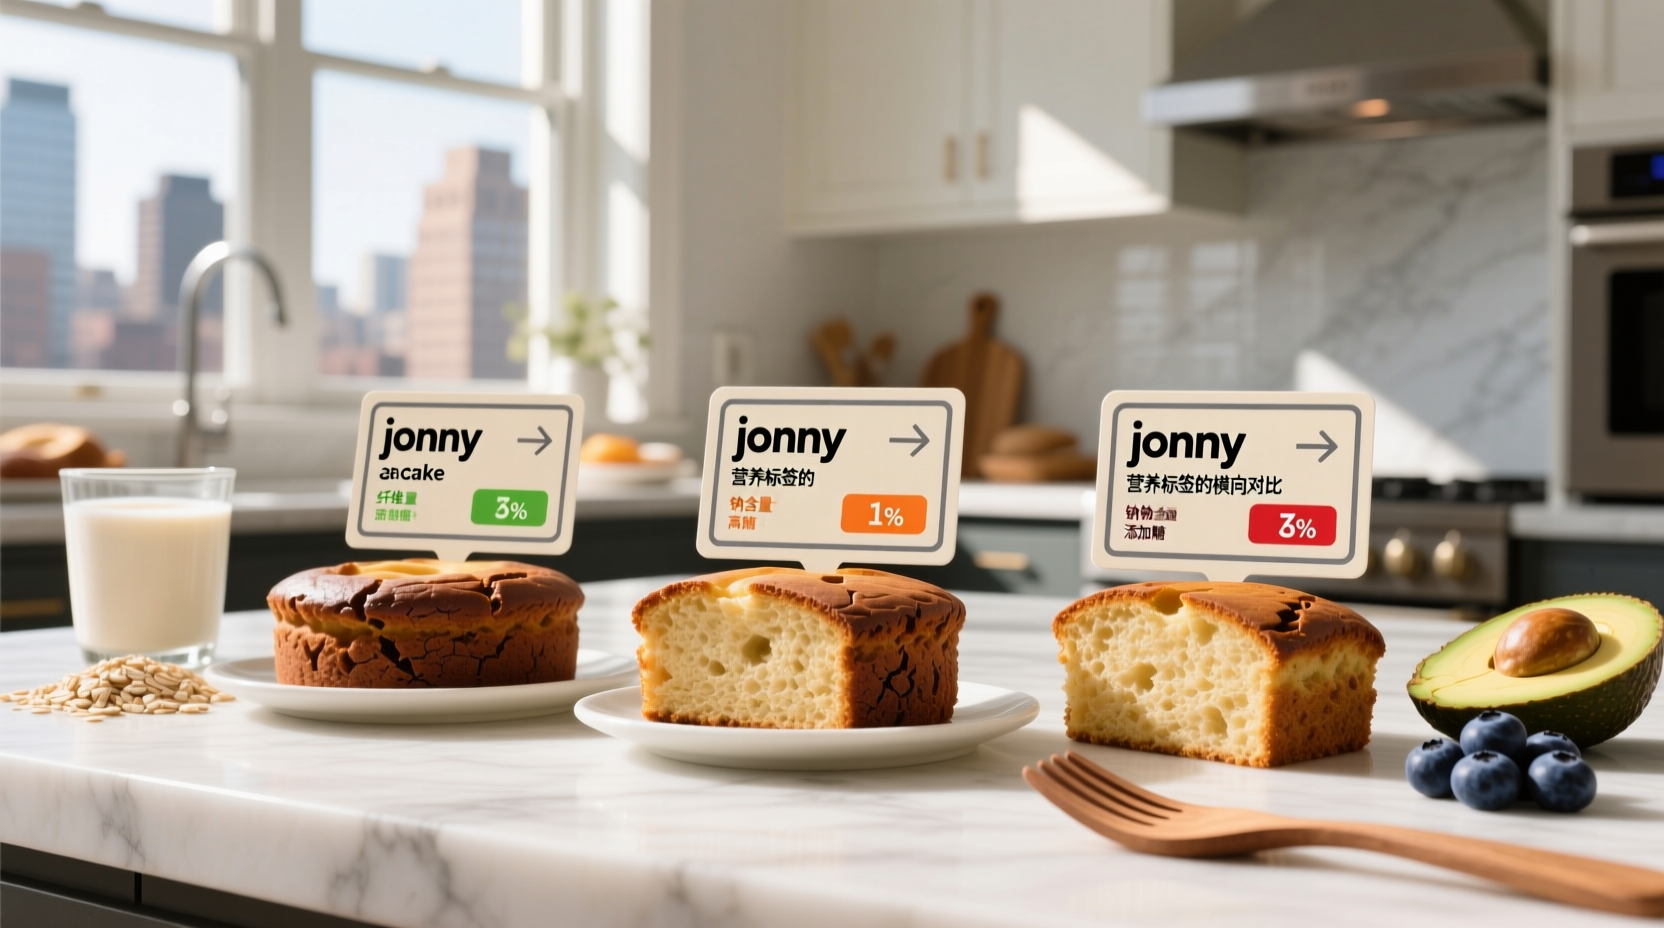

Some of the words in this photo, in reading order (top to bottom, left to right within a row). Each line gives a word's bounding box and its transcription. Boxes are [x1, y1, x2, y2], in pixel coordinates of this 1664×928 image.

[379, 417, 483, 462] jonny
[731, 415, 847, 463] jonny
[1126, 420, 1247, 470] jonny
[731, 467, 815, 487] 营养标签的
[868, 502, 904, 527] 1%
